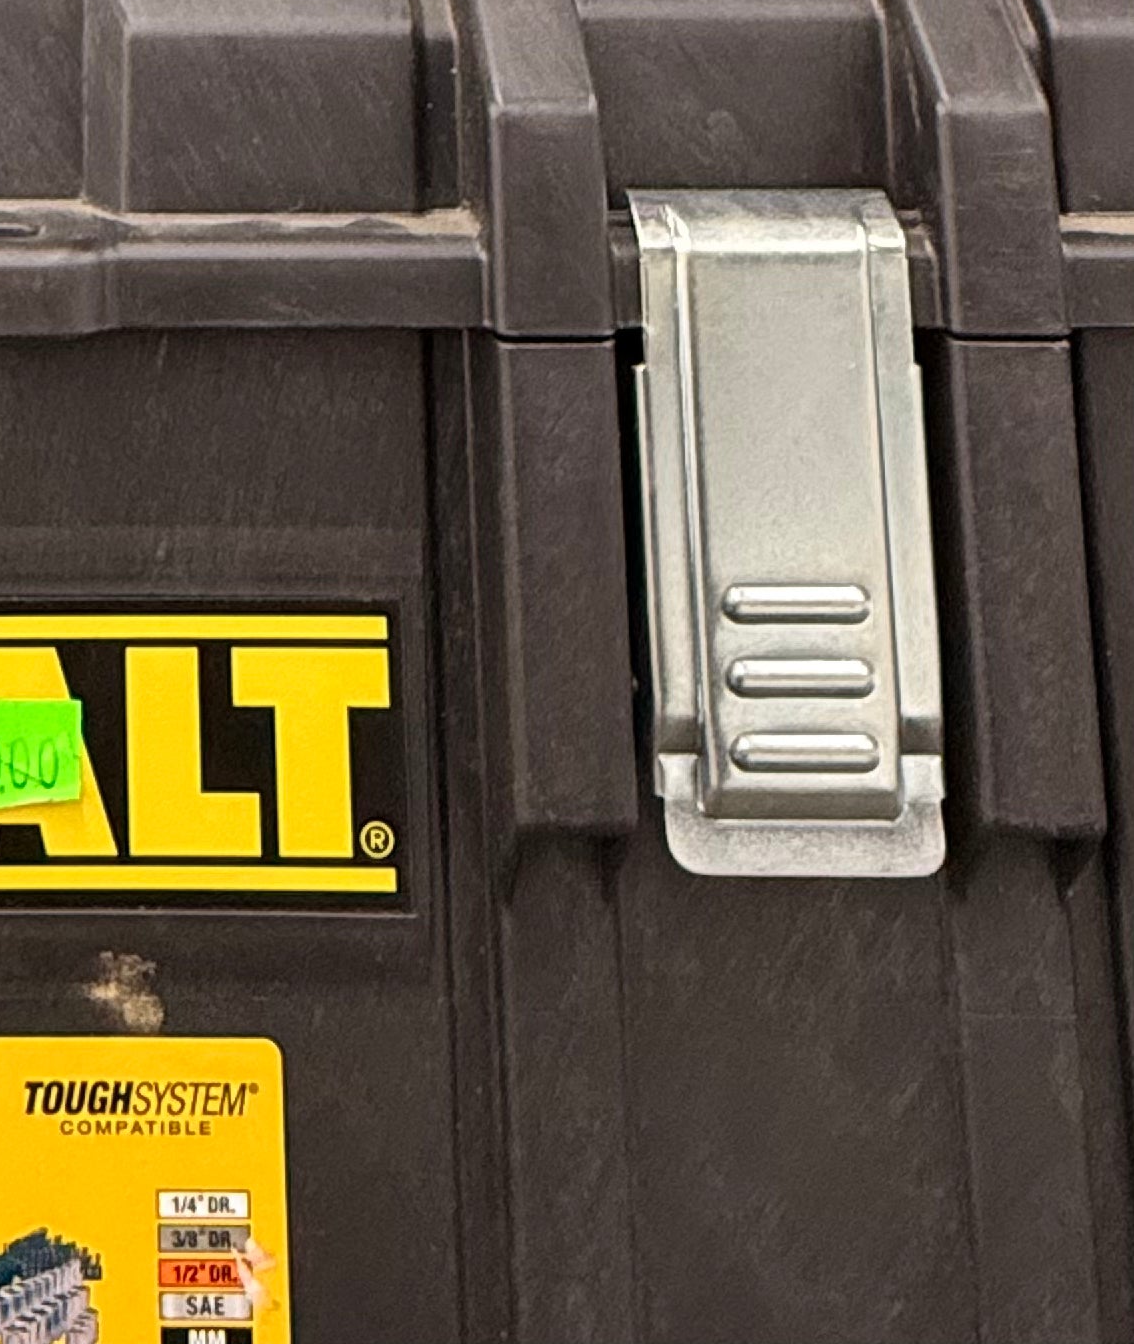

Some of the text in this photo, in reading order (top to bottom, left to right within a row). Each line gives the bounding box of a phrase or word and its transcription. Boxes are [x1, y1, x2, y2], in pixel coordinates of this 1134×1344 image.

[59, 1120, 212, 1136] COMPATIBLE
[208, 1196, 236, 1213] DR.
[209, 1230, 237, 1248] DR.
[209, 1265, 238, 1282] DR.
[186, 1297, 226, 1316] SAE
